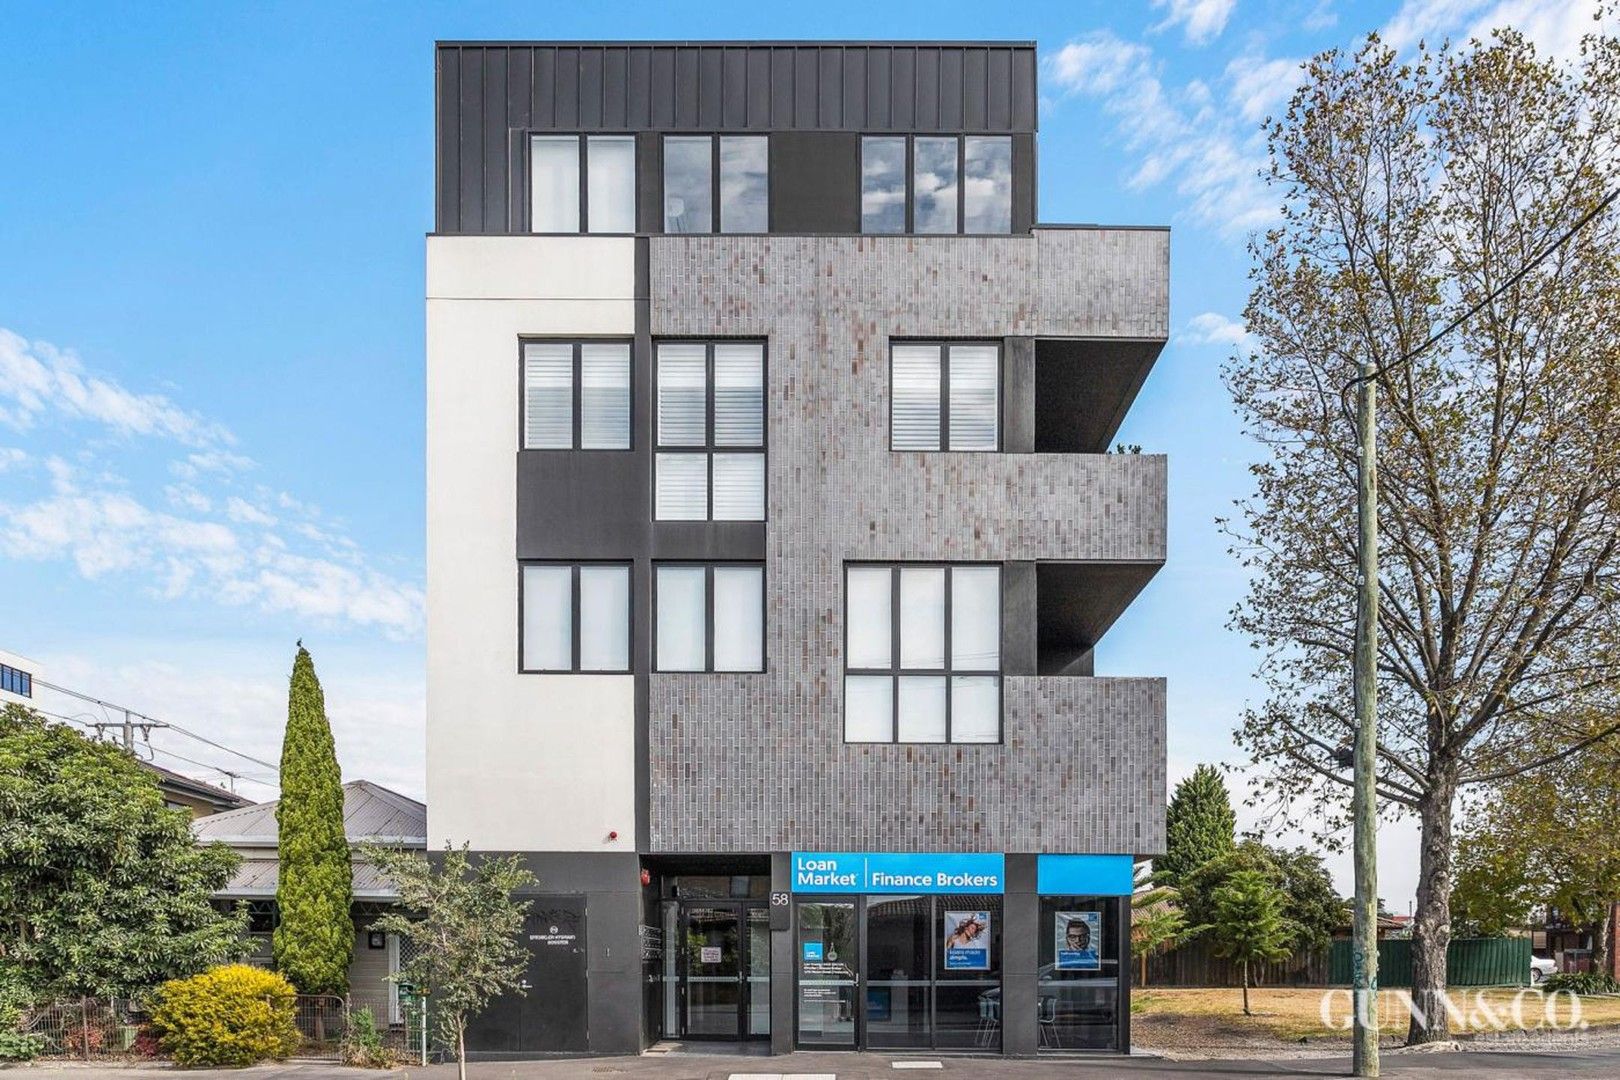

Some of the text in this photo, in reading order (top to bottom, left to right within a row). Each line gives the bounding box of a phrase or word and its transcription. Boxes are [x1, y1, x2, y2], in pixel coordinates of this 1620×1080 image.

[798, 857, 837, 871] Loan
[797, 872, 856, 886] Market
[872, 872, 998, 886] Finance Brokers
[772, 893, 789, 906] 58
